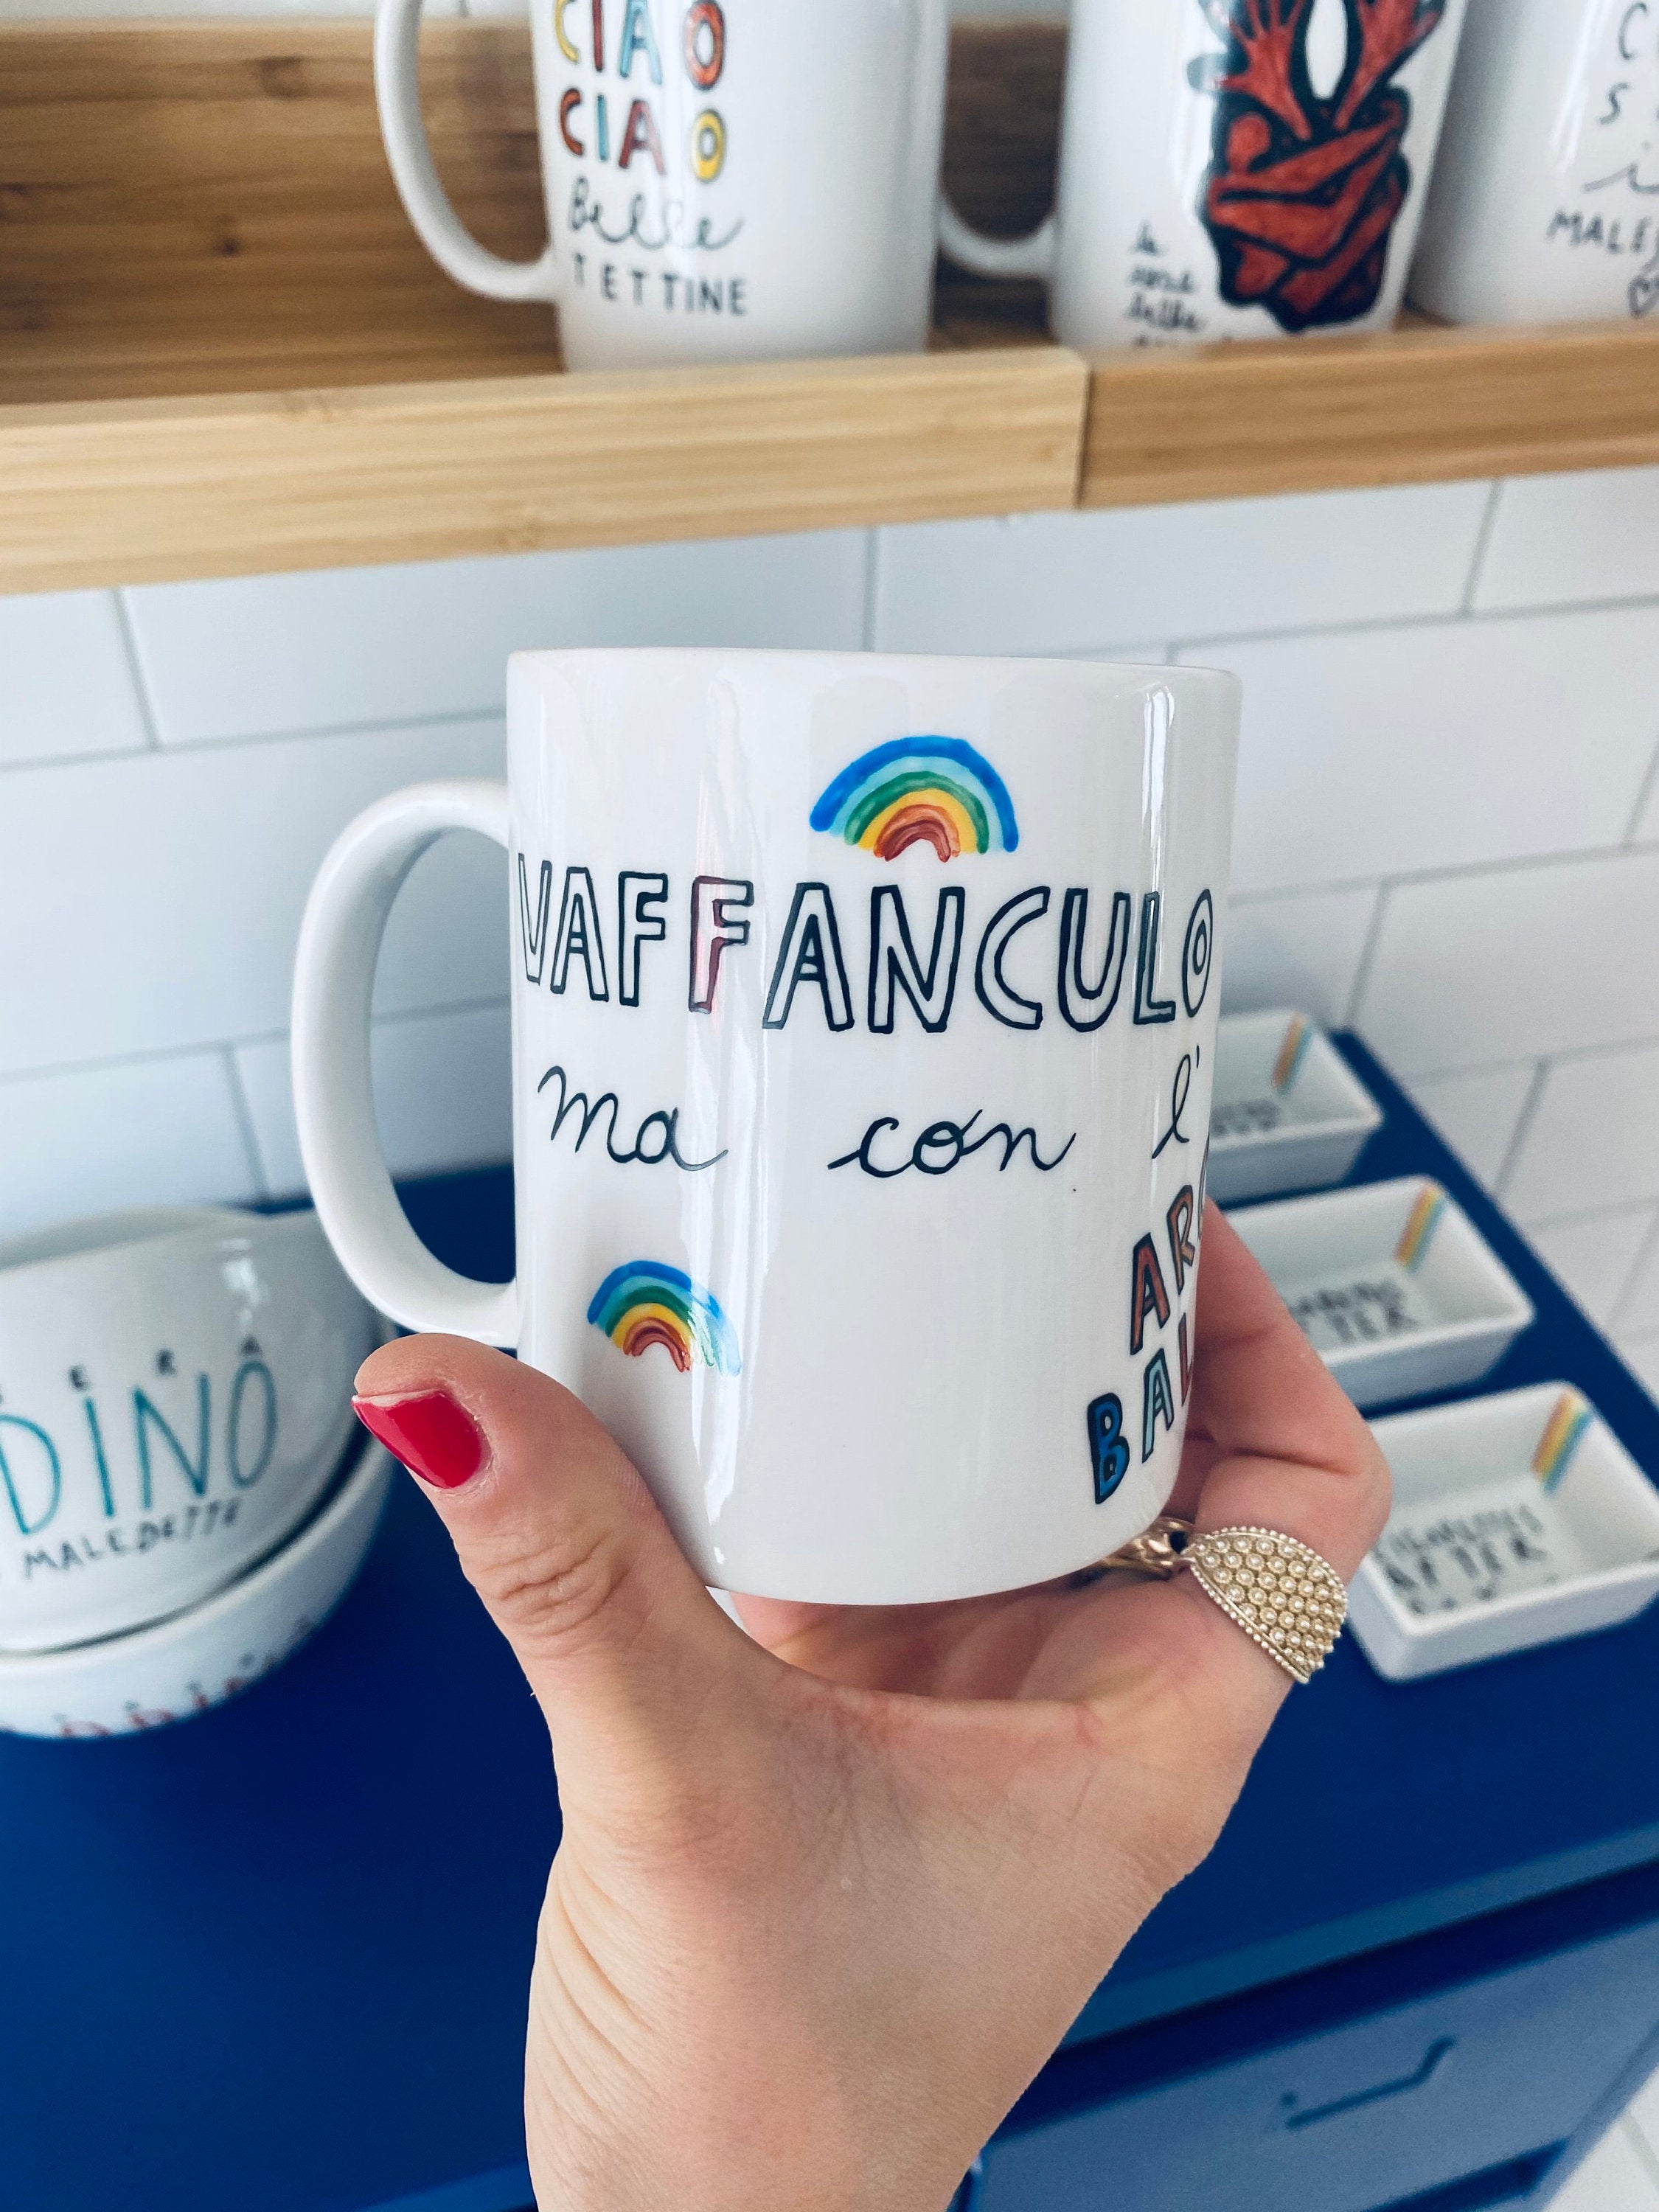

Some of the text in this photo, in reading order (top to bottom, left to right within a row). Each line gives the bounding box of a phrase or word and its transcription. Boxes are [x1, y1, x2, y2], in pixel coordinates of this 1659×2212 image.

[554, 0, 726, 90] CIAO
[559, 87, 726, 184] CIAO
[573, 253, 747, 316] TETTINE
[518, 852, 1214, 1034] VAFFANCULO
[538, 1065, 728, 1172] ma
[827, 1108, 1077, 1178] con
[1130, 1132, 1211, 1355] AR
